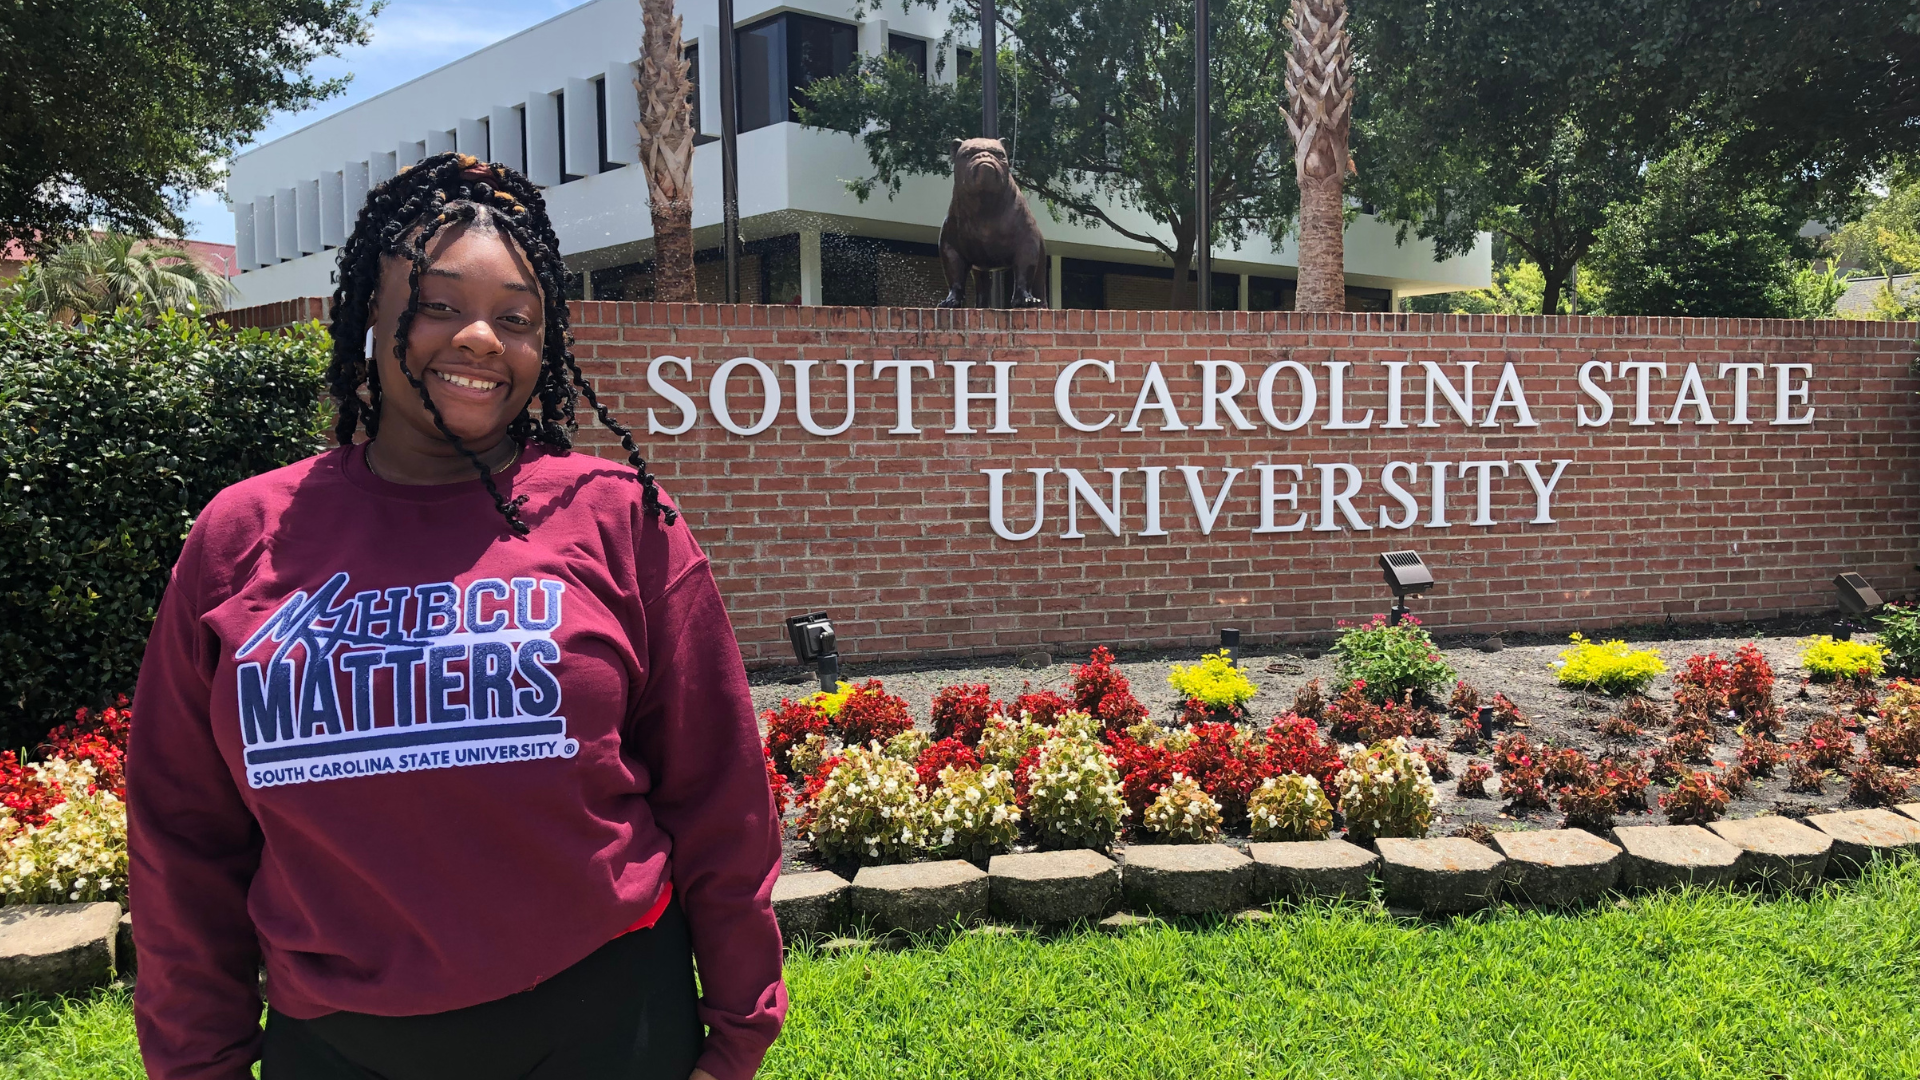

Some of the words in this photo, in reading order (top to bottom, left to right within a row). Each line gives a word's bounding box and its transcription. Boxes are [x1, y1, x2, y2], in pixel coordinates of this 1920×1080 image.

[646, 354, 1019, 437] SOUTH
[1053, 357, 1542, 433] CAROLINA
[1576, 359, 1817, 428] STATE
[978, 458, 1574, 542] UNIVERSITY
[357, 578, 565, 641] HBCU
[239, 639, 560, 745] MATTERS
[253, 766, 305, 786] SOUTH
[309, 756, 394, 779] CAROLINA
[398, 750, 450, 769] STATE
[454, 740, 558, 763] UNIVERSITY
